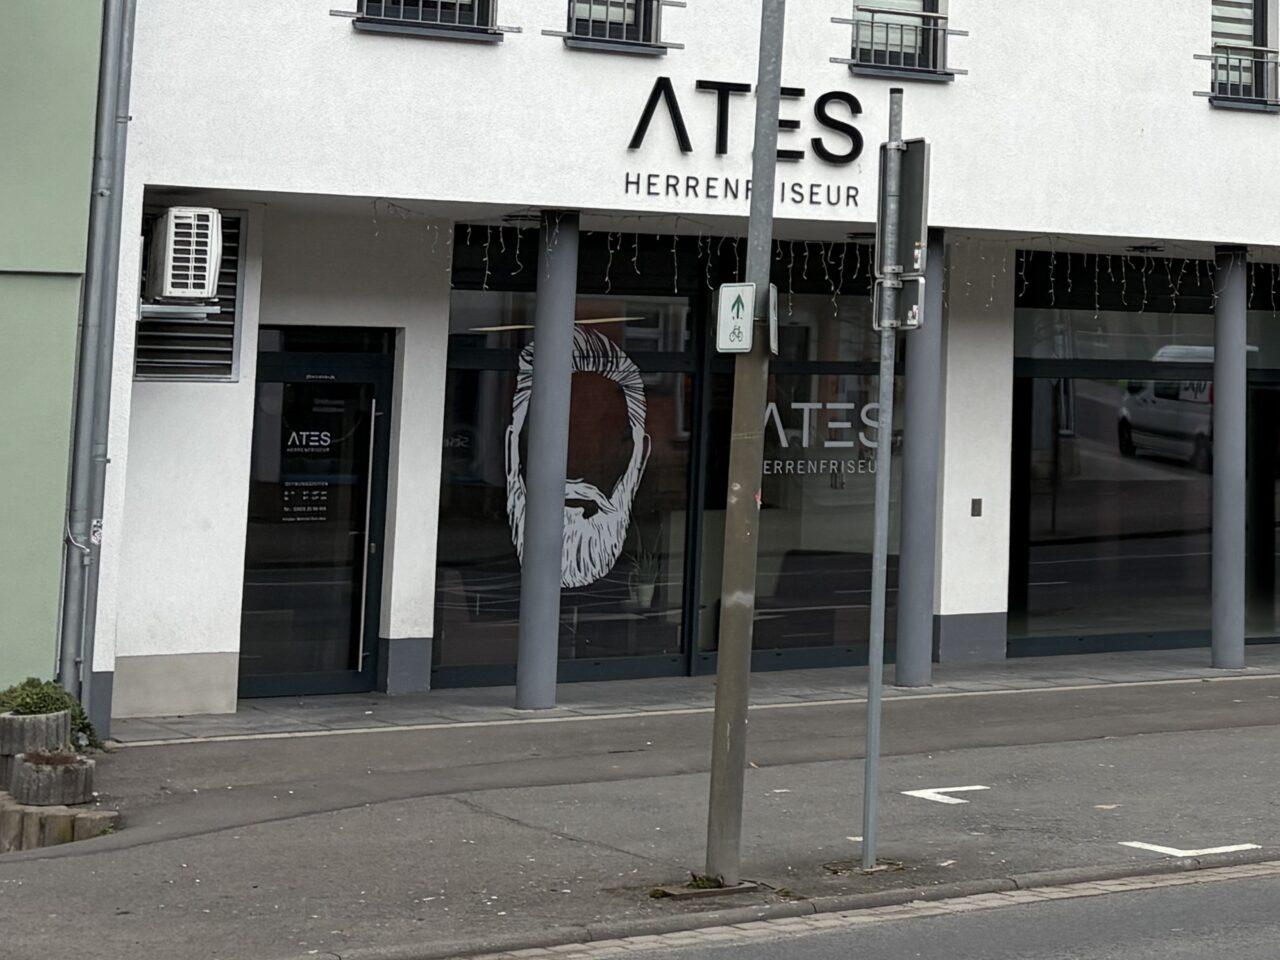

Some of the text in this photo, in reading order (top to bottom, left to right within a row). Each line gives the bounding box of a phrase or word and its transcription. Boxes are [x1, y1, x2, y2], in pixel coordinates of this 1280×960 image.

[625, 172, 860, 207] HERRENFISEUR
[287, 431, 332, 446] ATES
[763, 459, 878, 474] ERRENFRISEU
